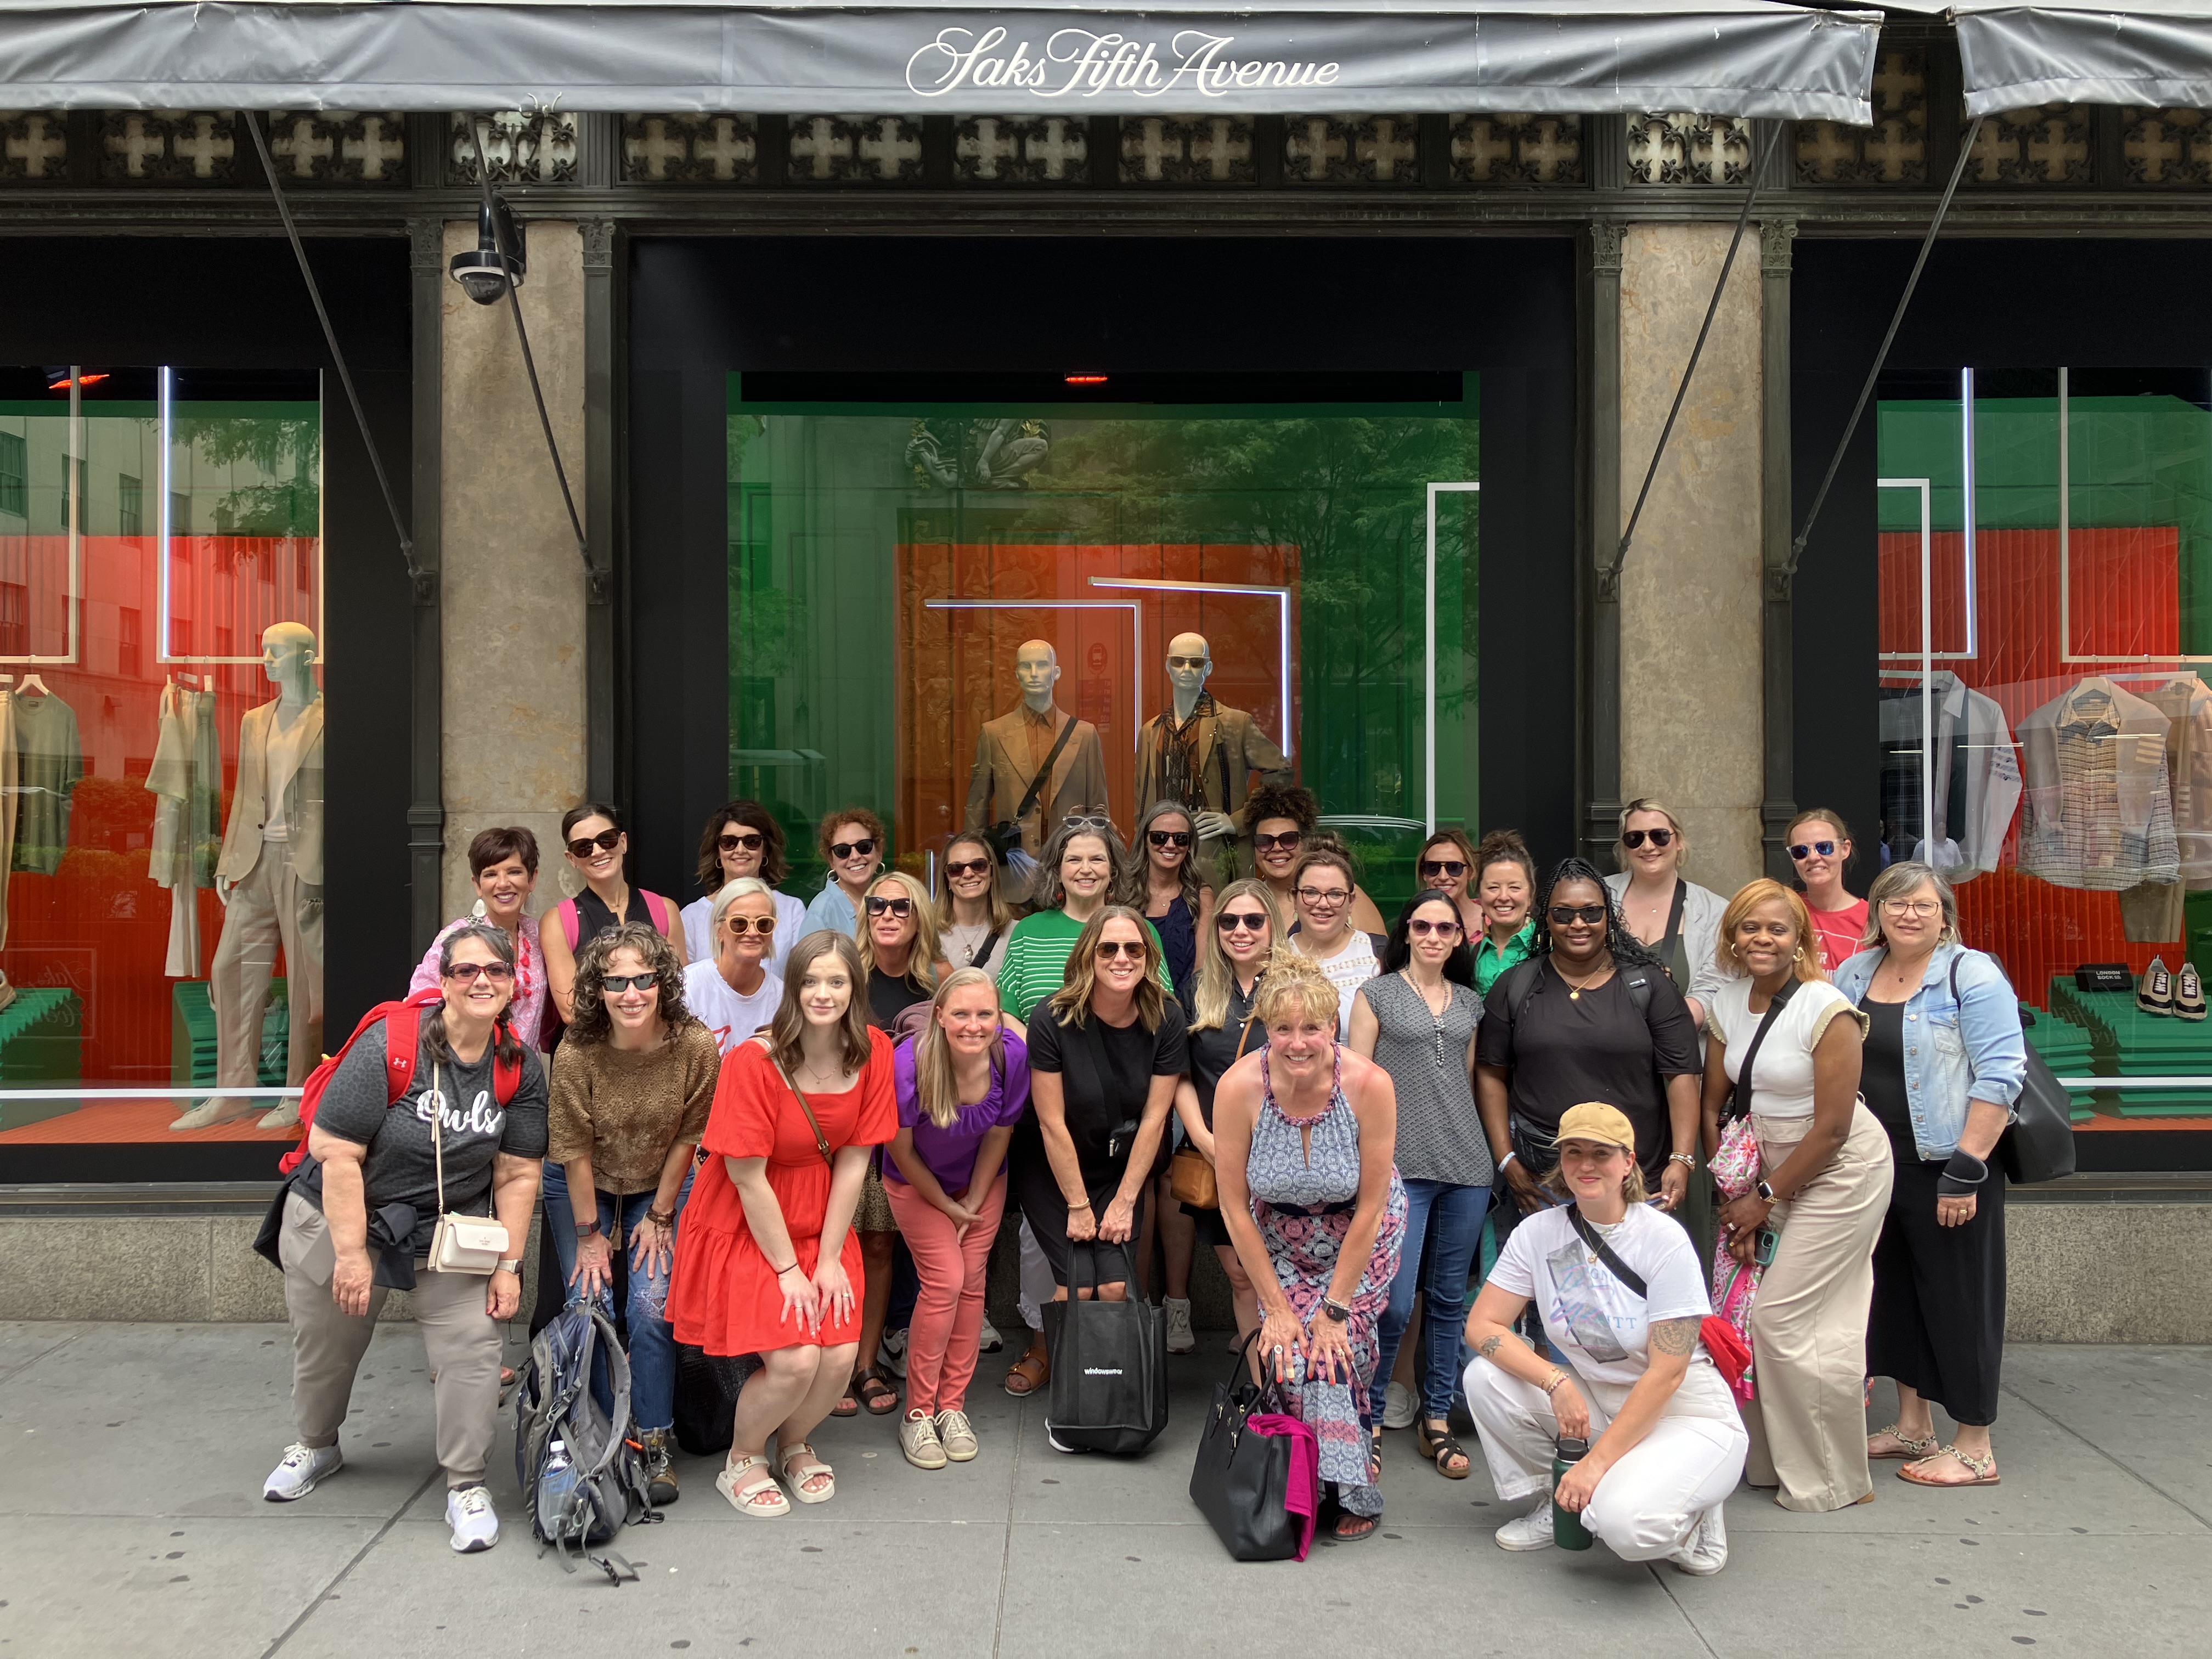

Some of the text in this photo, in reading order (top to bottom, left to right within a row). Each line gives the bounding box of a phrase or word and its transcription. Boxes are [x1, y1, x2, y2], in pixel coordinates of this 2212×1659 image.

[906, 26, 1339, 97] Saks Fifth Avenue
[416, 1089, 501, 1134] Owls
[1084, 1367, 1123, 1375] windowswear
